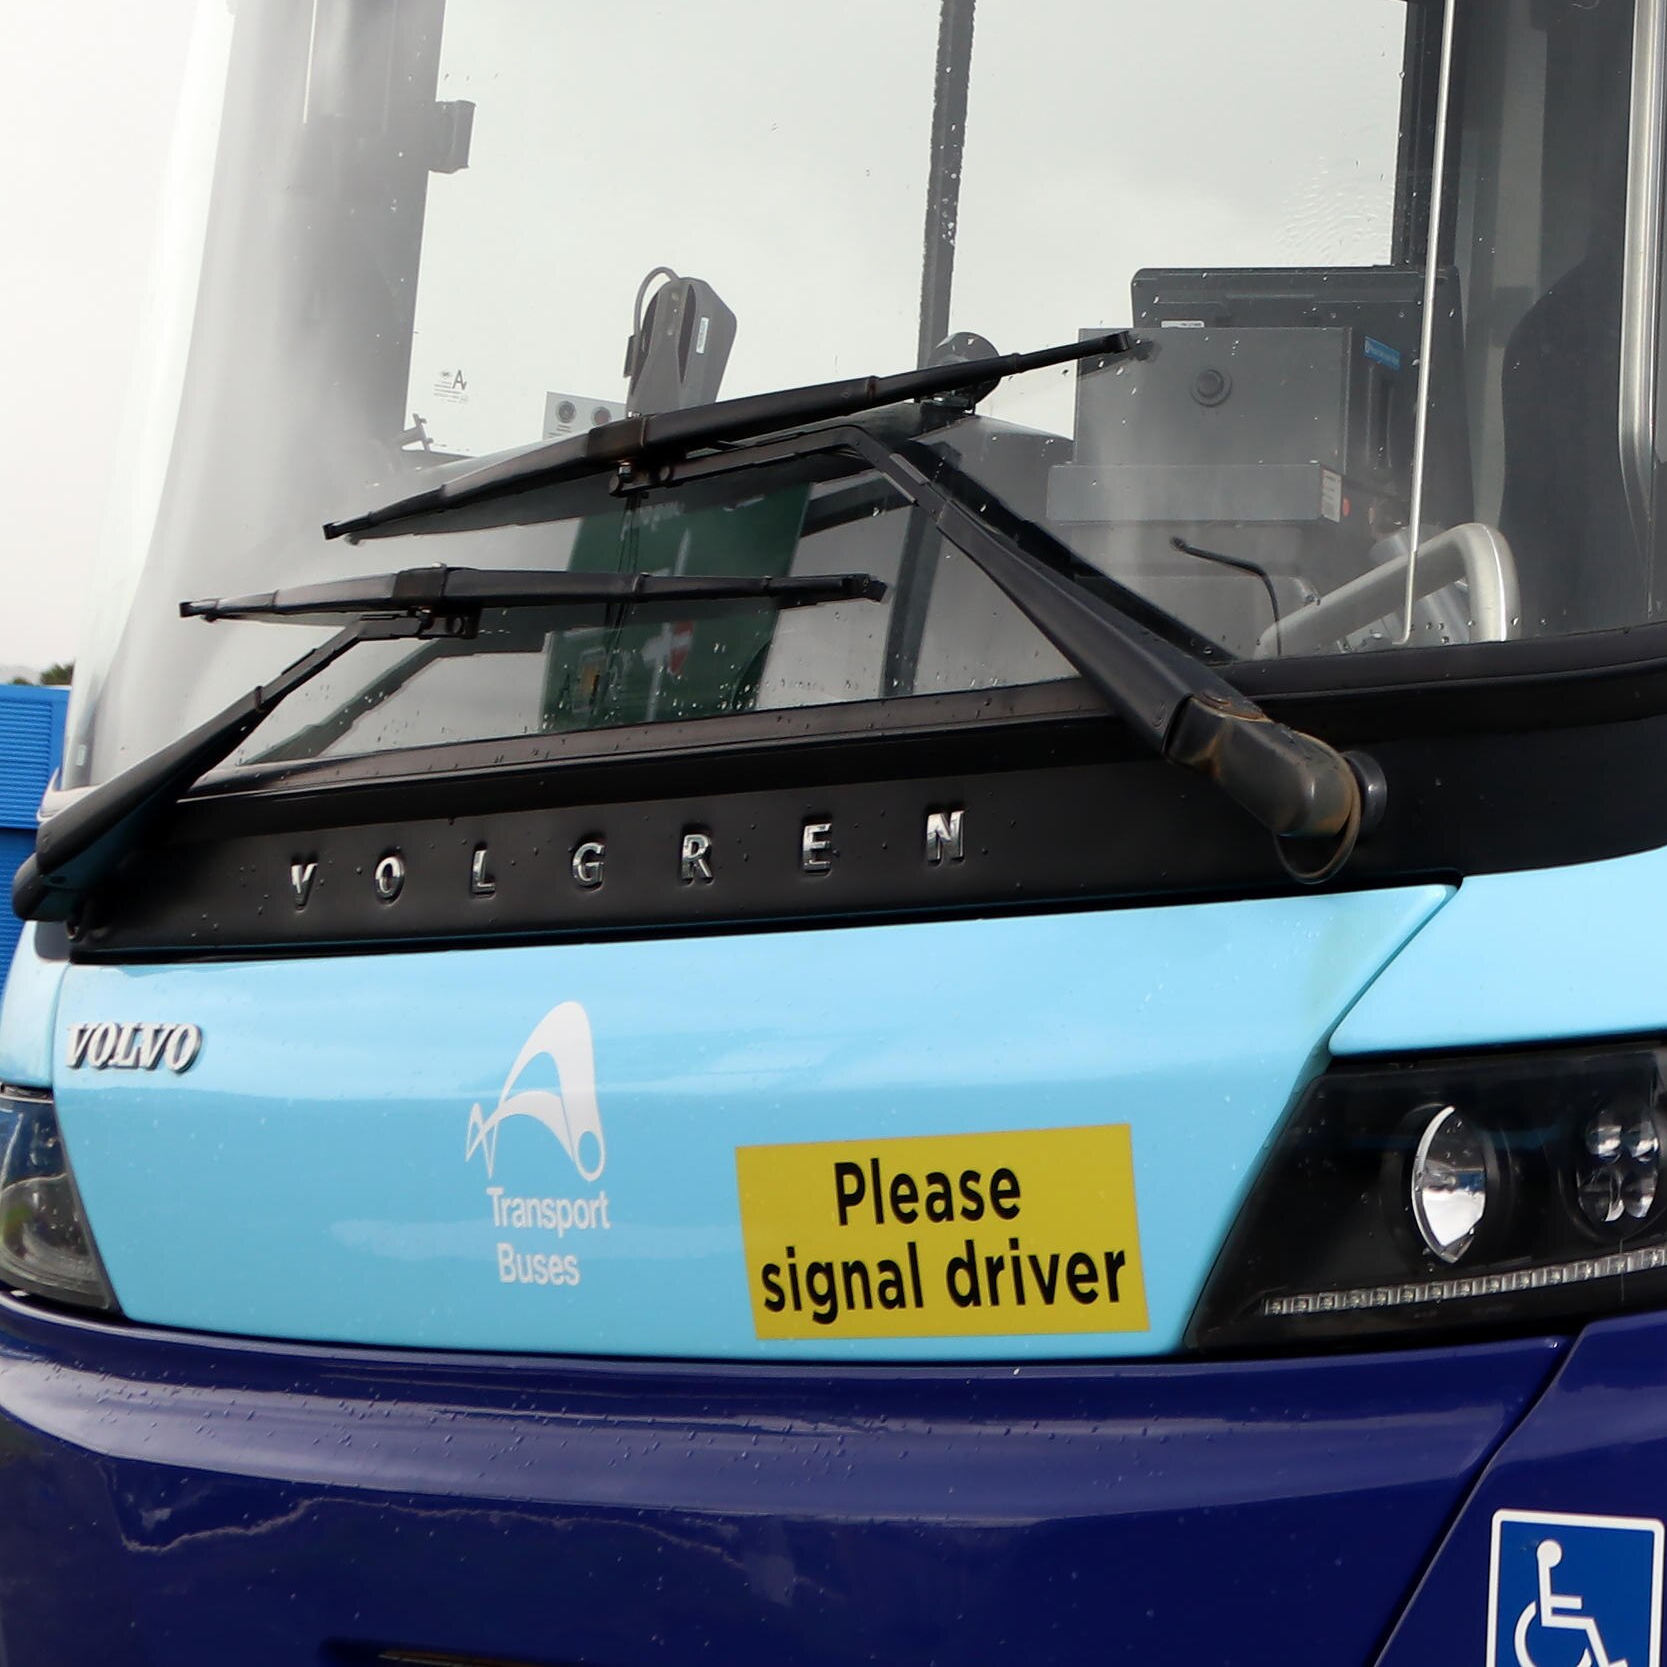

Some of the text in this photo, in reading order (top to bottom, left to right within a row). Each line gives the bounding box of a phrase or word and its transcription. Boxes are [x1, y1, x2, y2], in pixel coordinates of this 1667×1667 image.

[290, 810, 966, 912] VOLGREN
[64, 1022, 203, 1074] VOLVO
[485, 1186, 611, 1238] Transport
[834, 1157, 1021, 1227] Please
[496, 1242, 580, 1286] Buses
[761, 1237, 1126, 1325] signal driver
